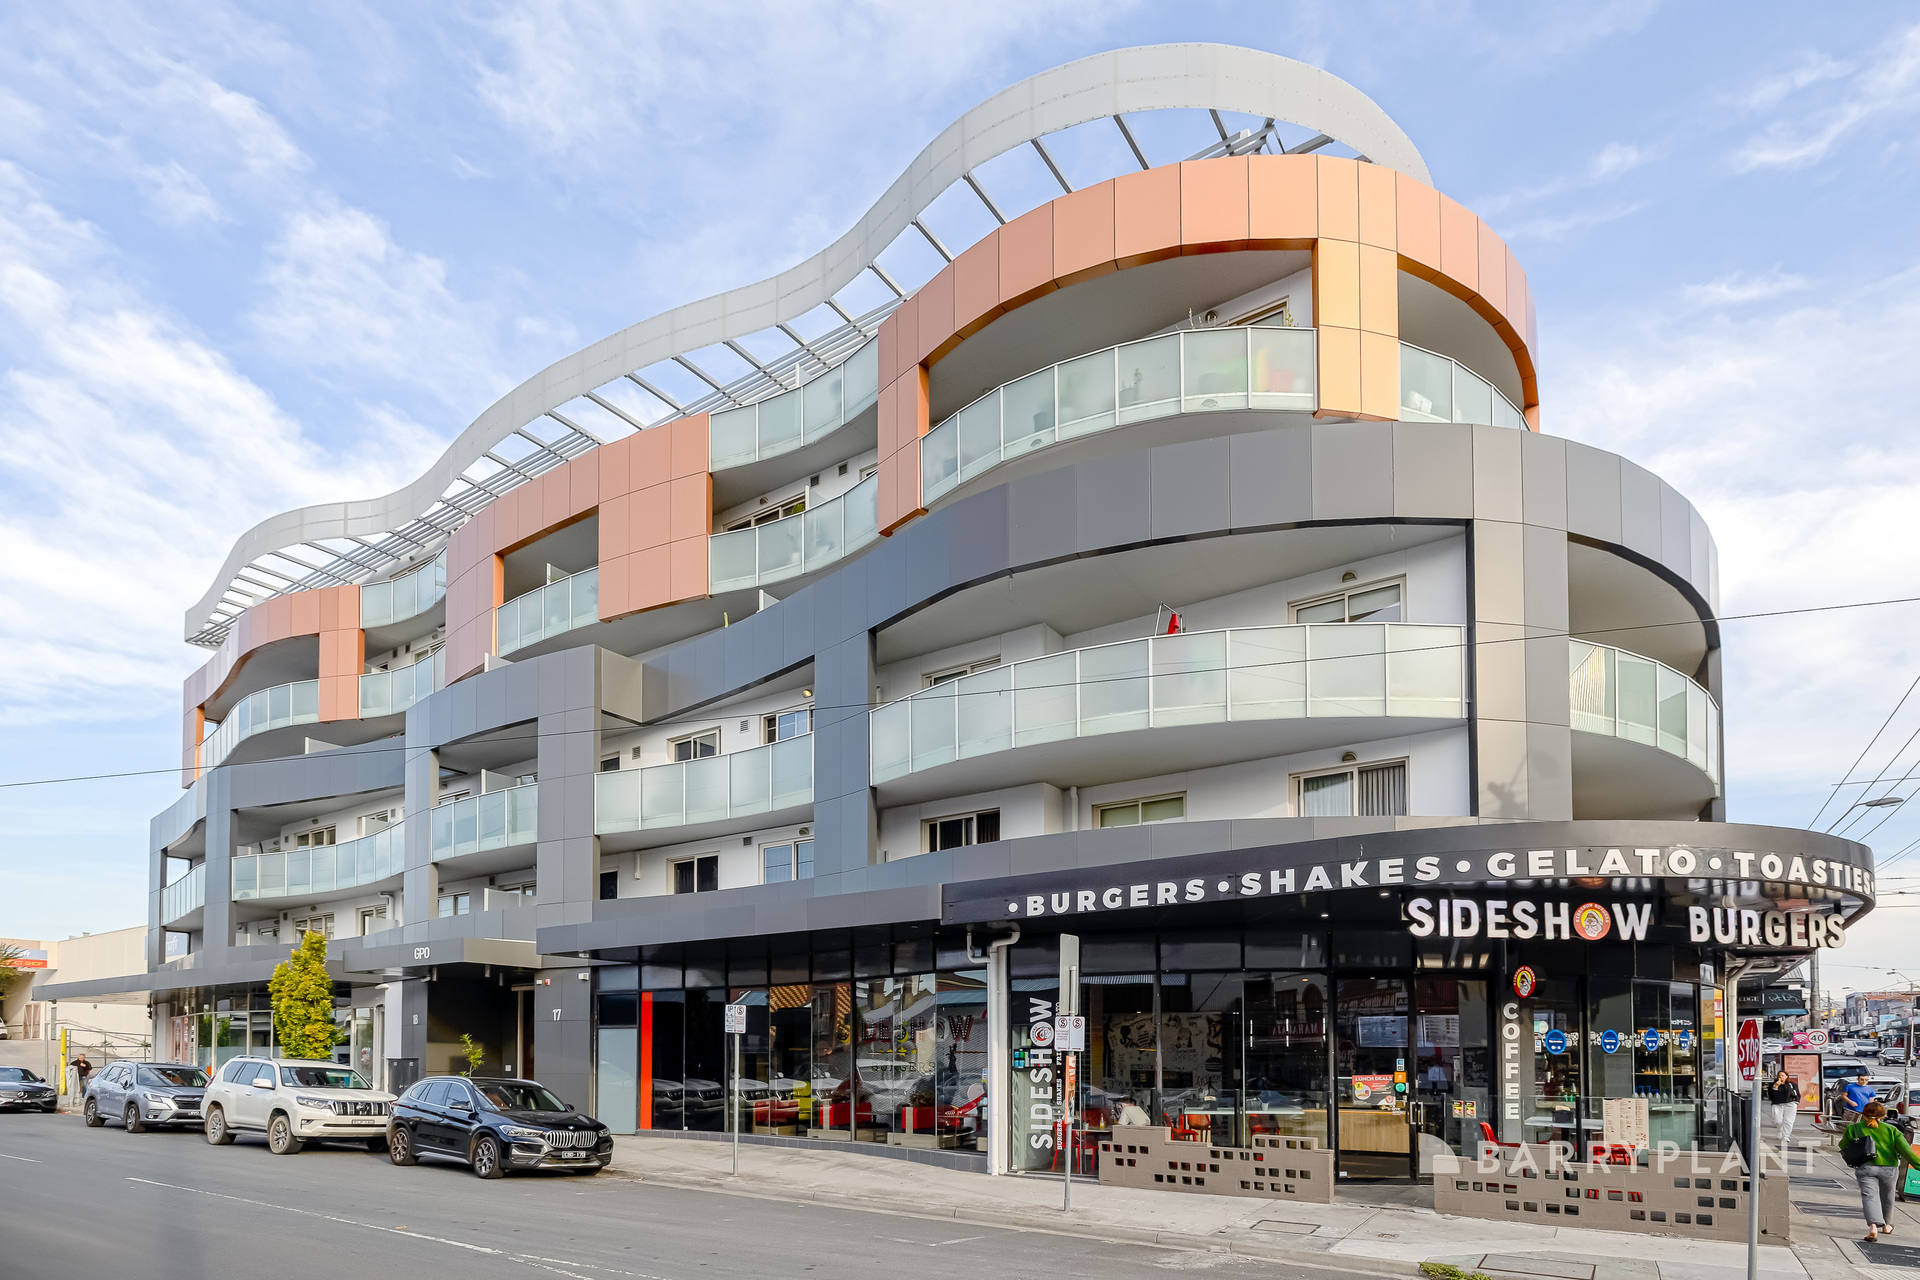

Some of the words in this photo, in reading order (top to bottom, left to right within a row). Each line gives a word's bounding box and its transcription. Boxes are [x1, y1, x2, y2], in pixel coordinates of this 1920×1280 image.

[1026, 879, 1205, 917] BURGERS
[1240, 856, 1440, 896] SHAKES
[1487, 849, 1697, 877] GELATO
[1733, 852, 1871, 895] TOASTIES
[1408, 898, 1652, 941] SIDESHOW
[1689, 906, 1846, 948] BURGERS
[414, 947, 430, 959] GPO
[552, 1008, 561, 1021] 17
[1739, 1038, 1759, 1062] STOP
[1811, 1034, 1824, 1042] 40
[1029, 997, 1053, 1149] SIDESHOW
[1502, 1002, 1520, 1120] COFFEE
